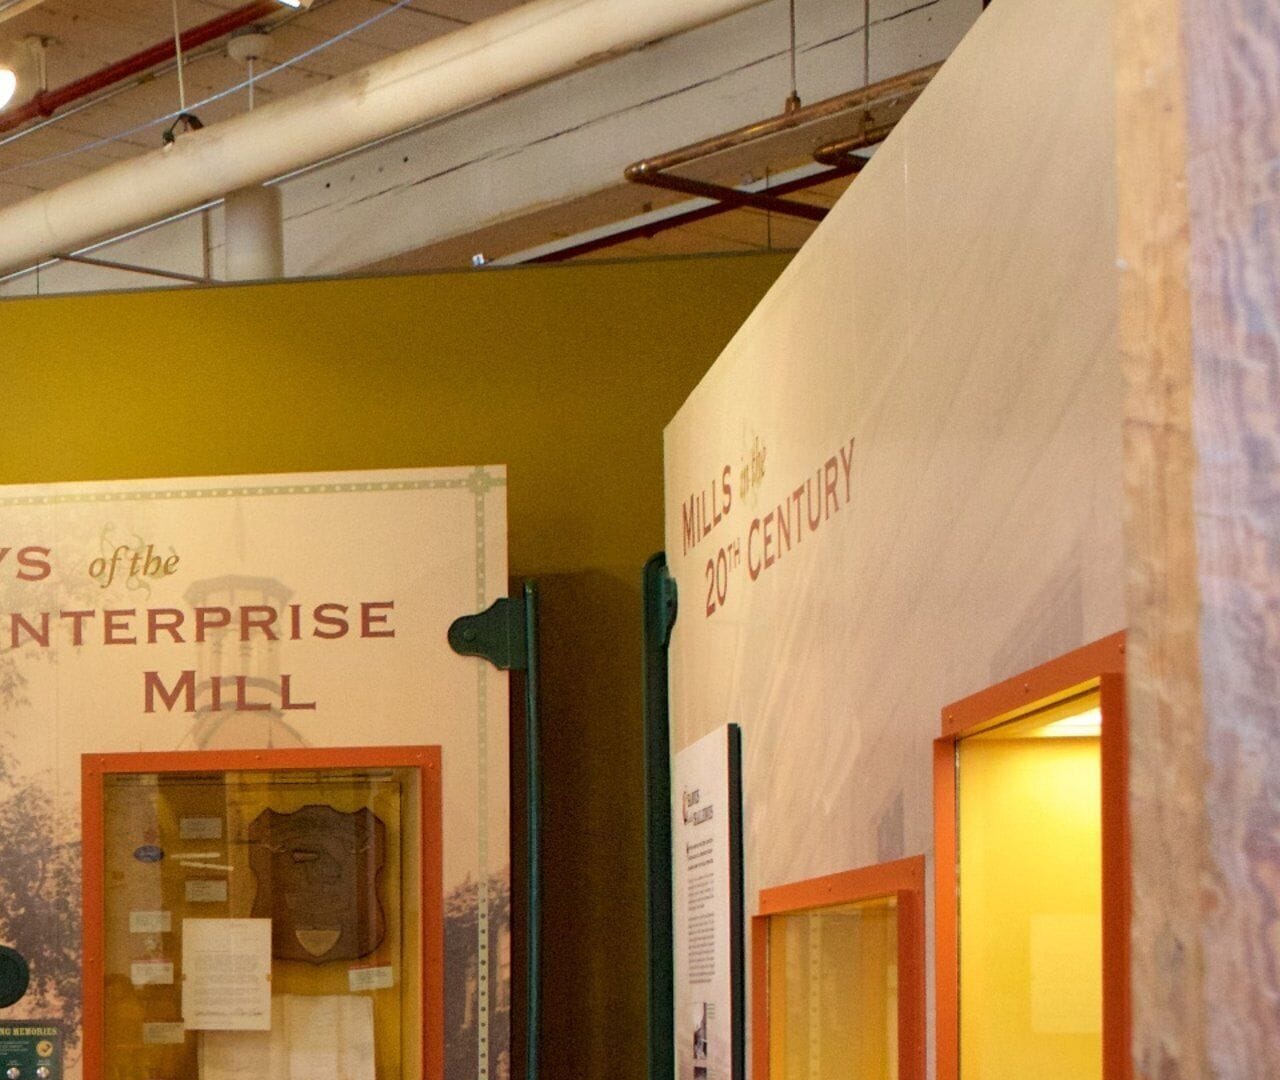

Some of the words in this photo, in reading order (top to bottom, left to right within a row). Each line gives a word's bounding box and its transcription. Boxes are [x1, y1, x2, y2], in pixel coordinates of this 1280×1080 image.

[682, 465, 732, 557] MILLS
[747, 436, 855, 582] CENTURY
[88, 544, 129, 588] of
[130, 544, 180, 576] the
[142, 670, 316, 714] MILL
